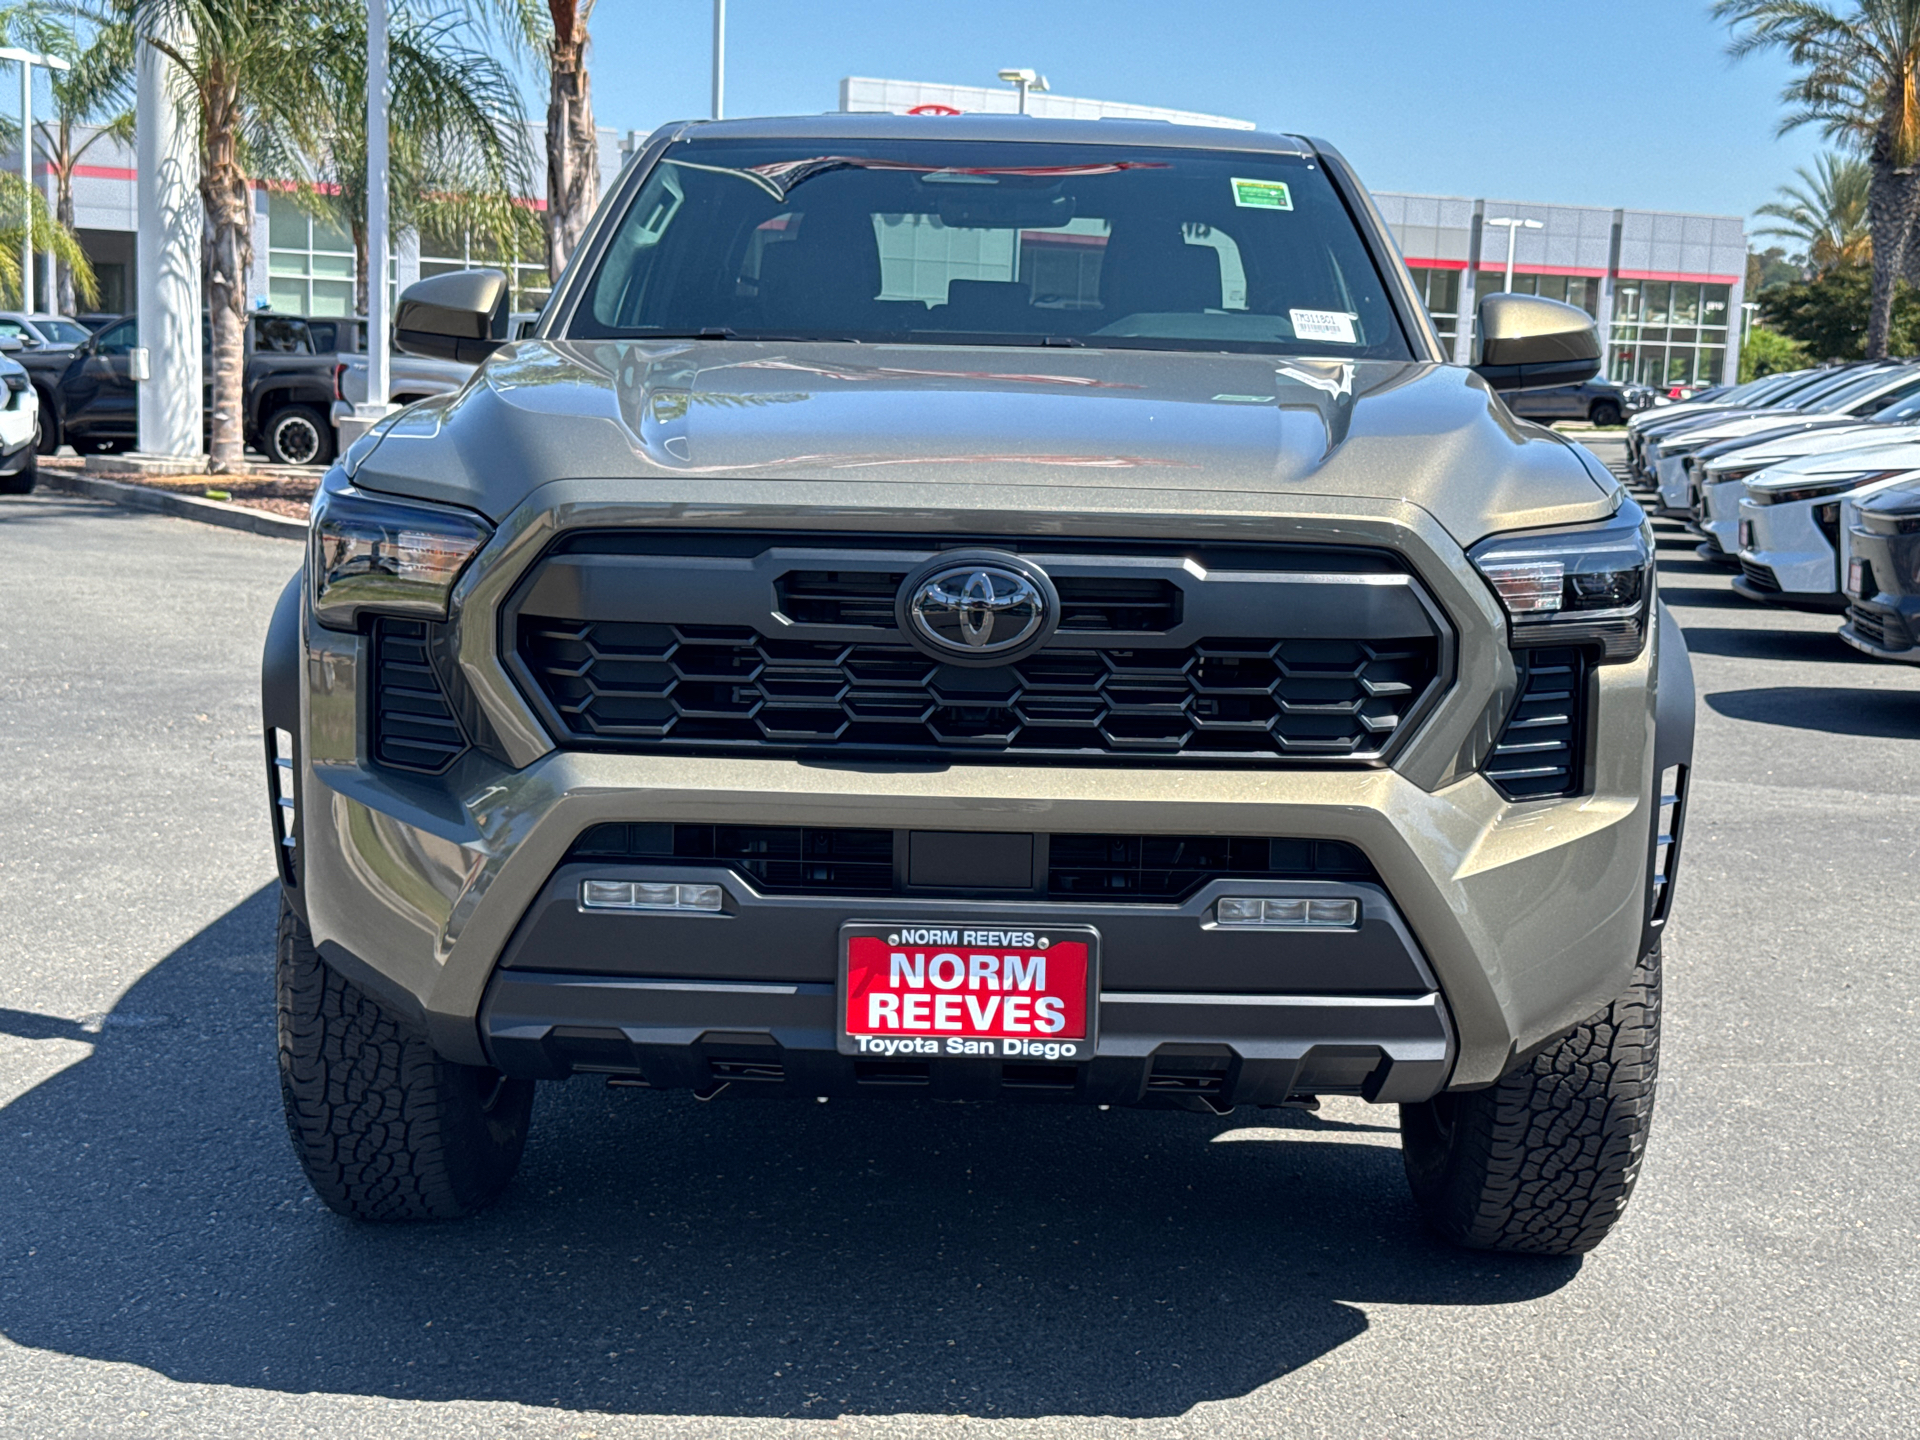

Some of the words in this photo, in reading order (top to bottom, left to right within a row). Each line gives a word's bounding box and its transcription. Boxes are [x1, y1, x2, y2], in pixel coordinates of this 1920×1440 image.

[901, 929, 958, 946] NORM
[963, 931, 1035, 948] REEVES
[889, 953, 1046, 991] NORM
[868, 993, 1065, 1033] REEVES
[855, 1035, 939, 1056] Toyota
[946, 1037, 995, 1055] San
[1002, 1038, 1077, 1060] Diego
